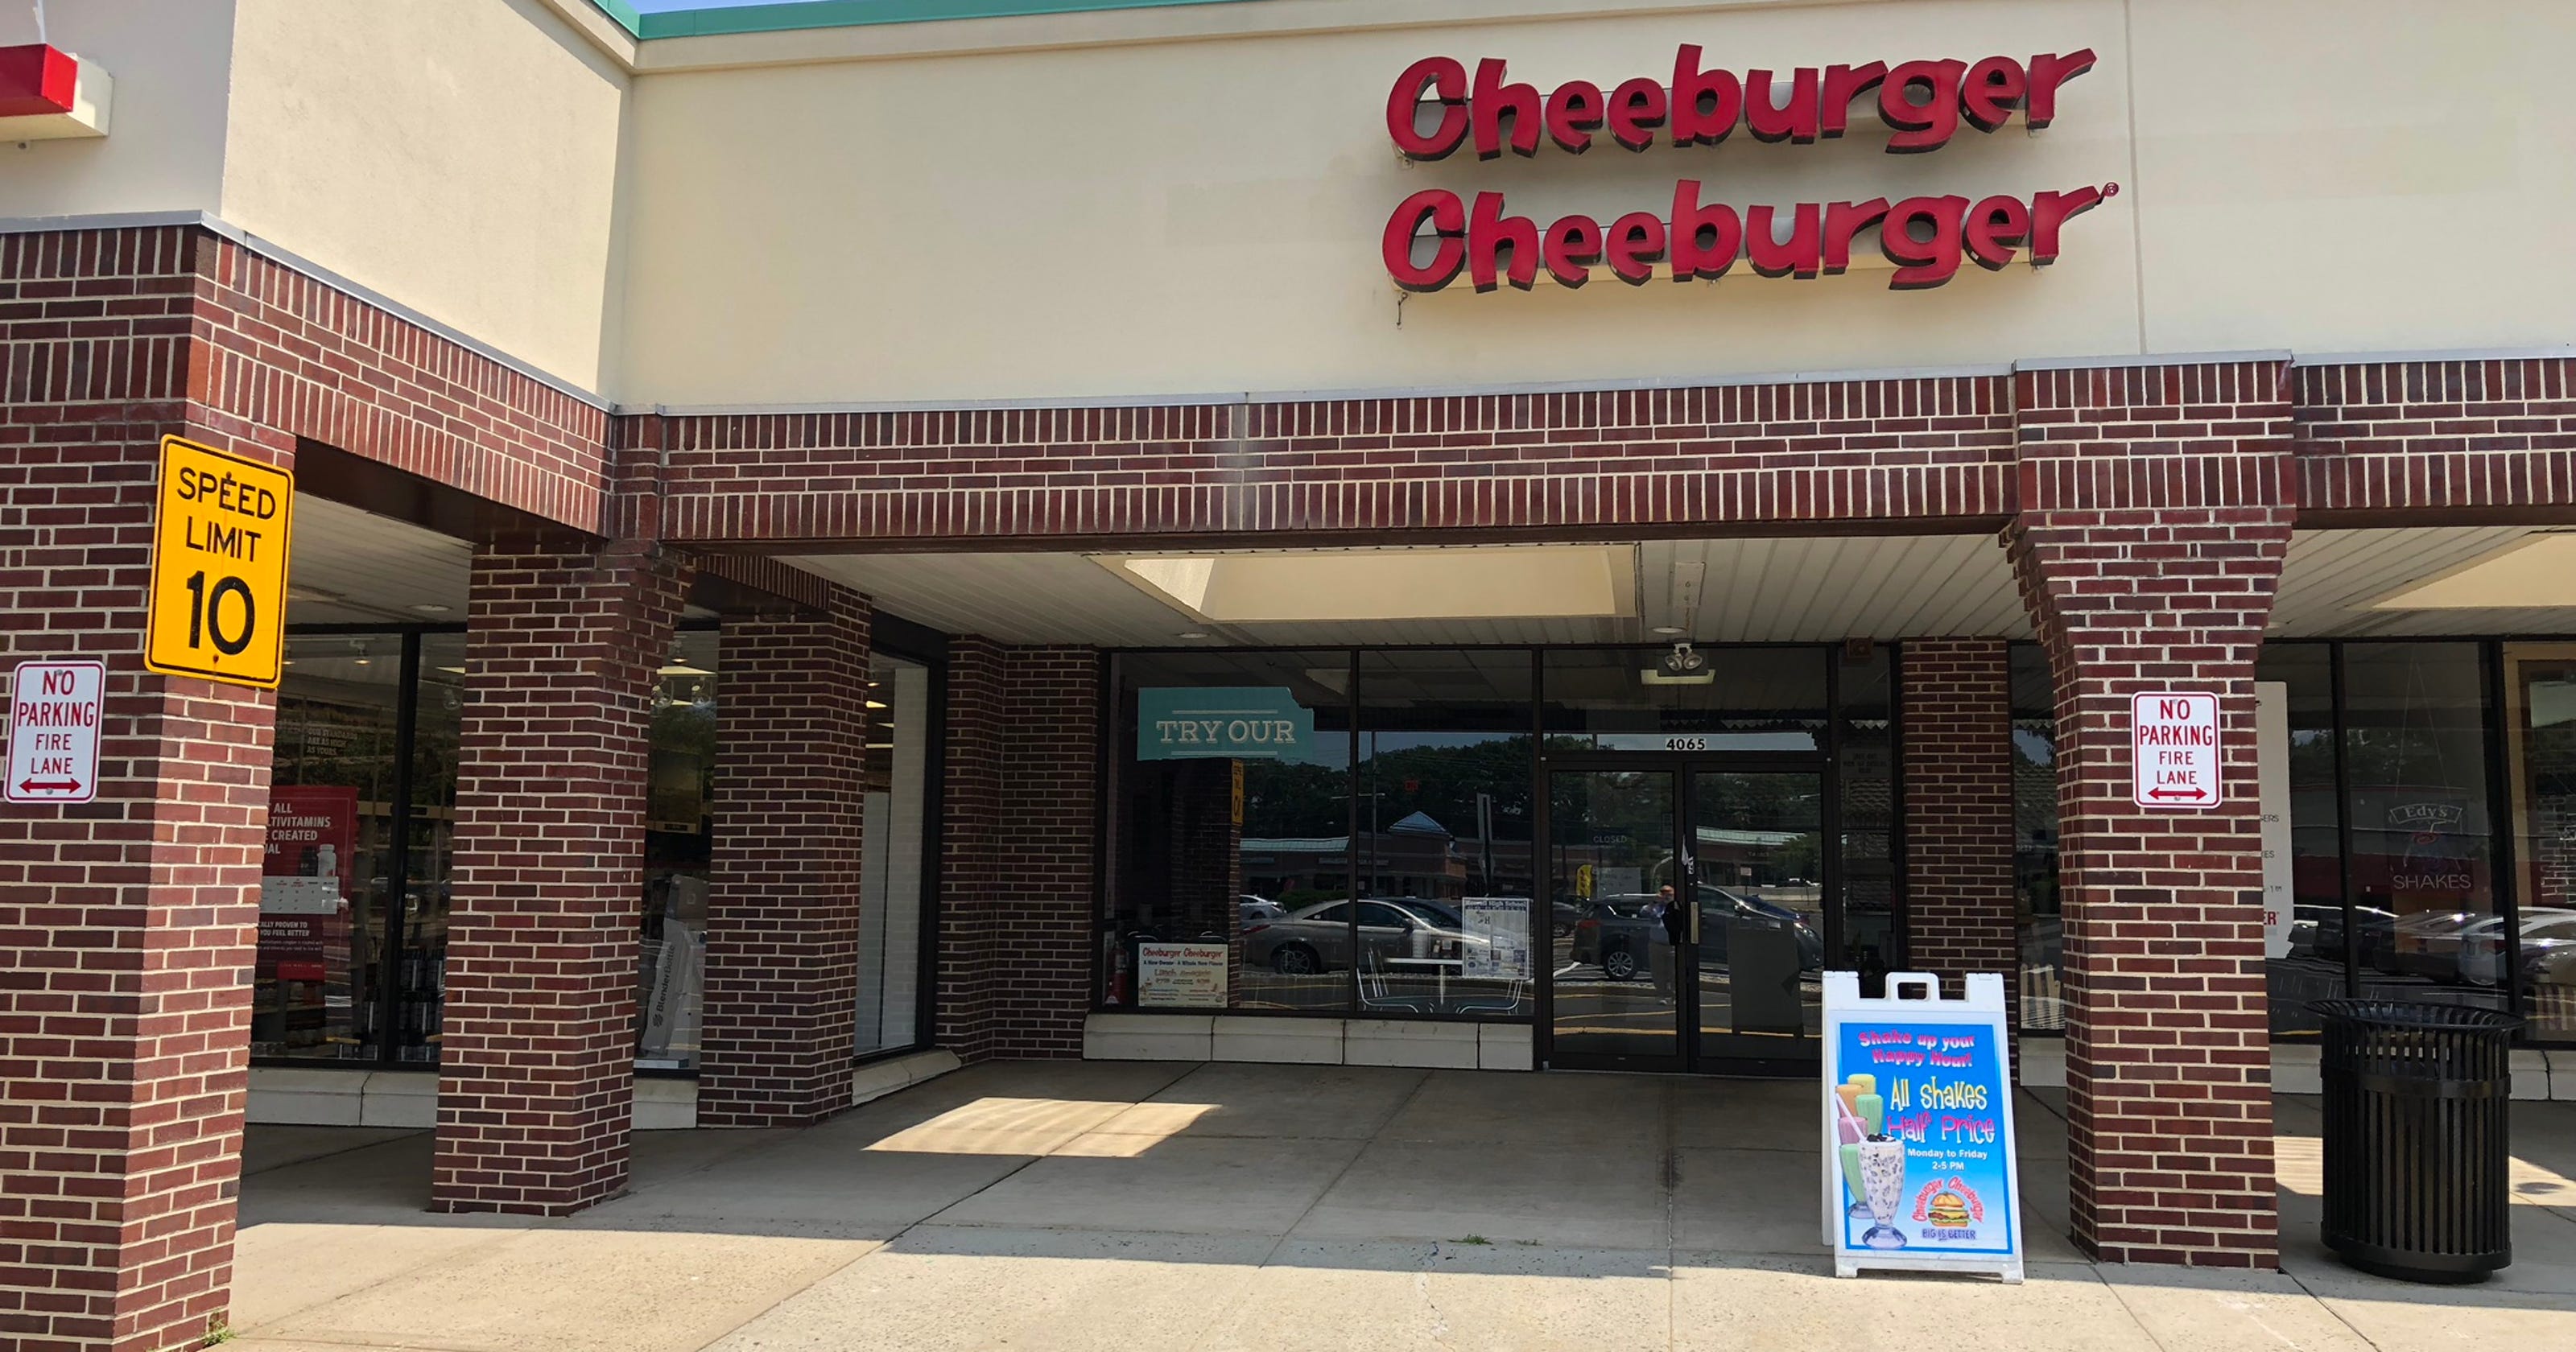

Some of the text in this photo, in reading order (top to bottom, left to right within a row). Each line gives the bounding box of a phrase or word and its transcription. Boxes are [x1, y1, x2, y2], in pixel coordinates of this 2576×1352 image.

[1385, 43, 2097, 160] Cheeburger
[177, 467, 276, 520] SPEED
[186, 515, 262, 563] LIMIT
[187, 571, 255, 655] 10
[42, 670, 75, 695] NO
[18, 701, 95, 727] PARKING
[2160, 699, 2190, 719] NO
[1156, 719, 1297, 744] TRY OUR
[2140, 725, 2213, 746] PARKING
[35, 734, 72, 750] FIRE
[1666, 739, 1705, 750] 4065
[31, 757, 73, 774] LANE
[2159, 751, 2194, 765] FIRE
[2157, 770, 2197, 784] LANE
[274, 803, 292, 814] ALL
[2405, 806, 2448, 818] Edy's
[271, 830, 318, 841] CREATED
[1593, 835, 1627, 843] CLOSED
[2393, 874, 2471, 889] SHAKES
[1859, 1029, 1975, 1051] Shake up your
[1872, 1049, 1973, 1067] Happy Hour!
[1890, 1075, 1988, 1111] All shakes
[1887, 1111, 1996, 1144] Half Price
[1907, 1148, 1988, 1160] Monday to Friday
[1933, 1161, 1965, 1170] 2-5 PM
[1922, 1228, 1936, 1239] BIG
[1948, 1229, 1976, 1239] BETTER
